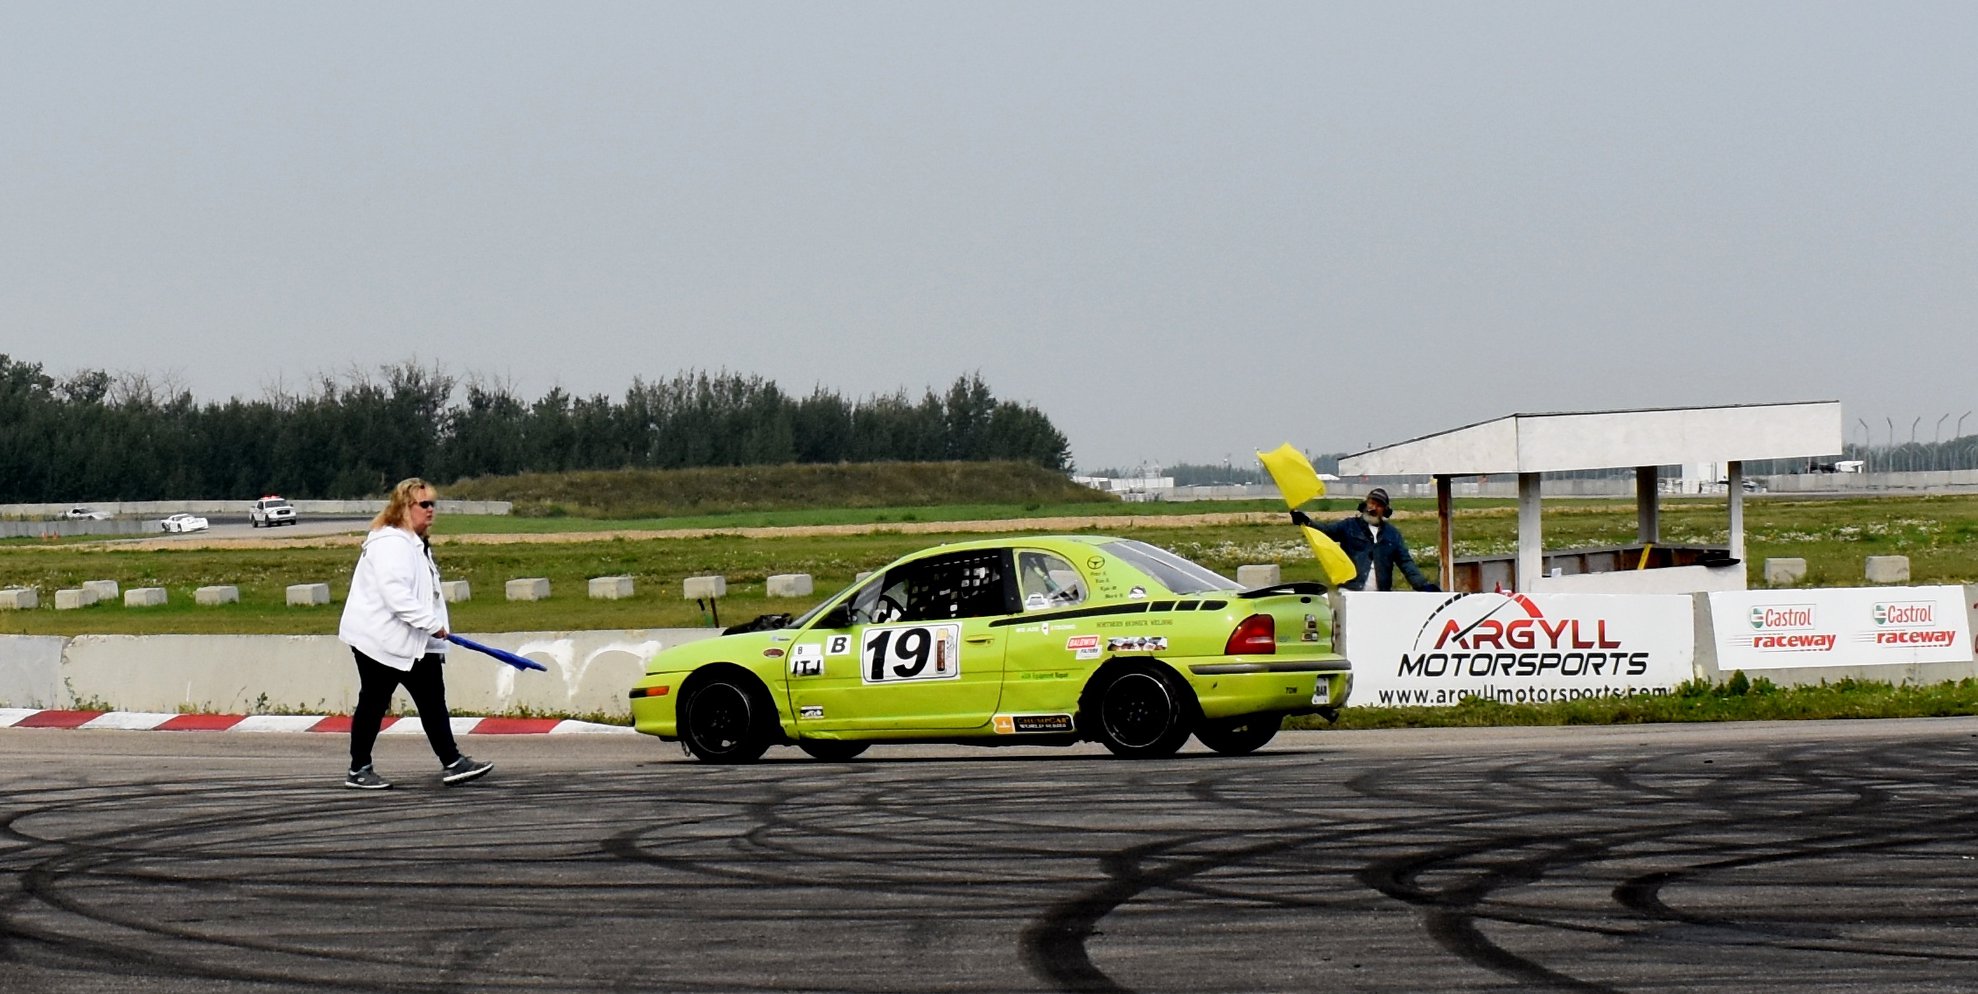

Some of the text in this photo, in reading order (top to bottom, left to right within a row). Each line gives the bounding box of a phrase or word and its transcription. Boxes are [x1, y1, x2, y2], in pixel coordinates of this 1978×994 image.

[1765, 607, 1812, 627] Castrol
[1887, 604, 1933, 623] Castrol
[1434, 619, 1622, 650] ARGYLL
[1753, 634, 1837, 651] raceway
[1876, 630, 1956, 647] raceway
[798, 646, 803, 655] B
[831, 636, 847, 653] B
[866, 628, 931, 680] 19
[1397, 653, 1649, 677] MOTORSPORTS
[1379, 684, 1667, 703] www.argllmotorsportscom
